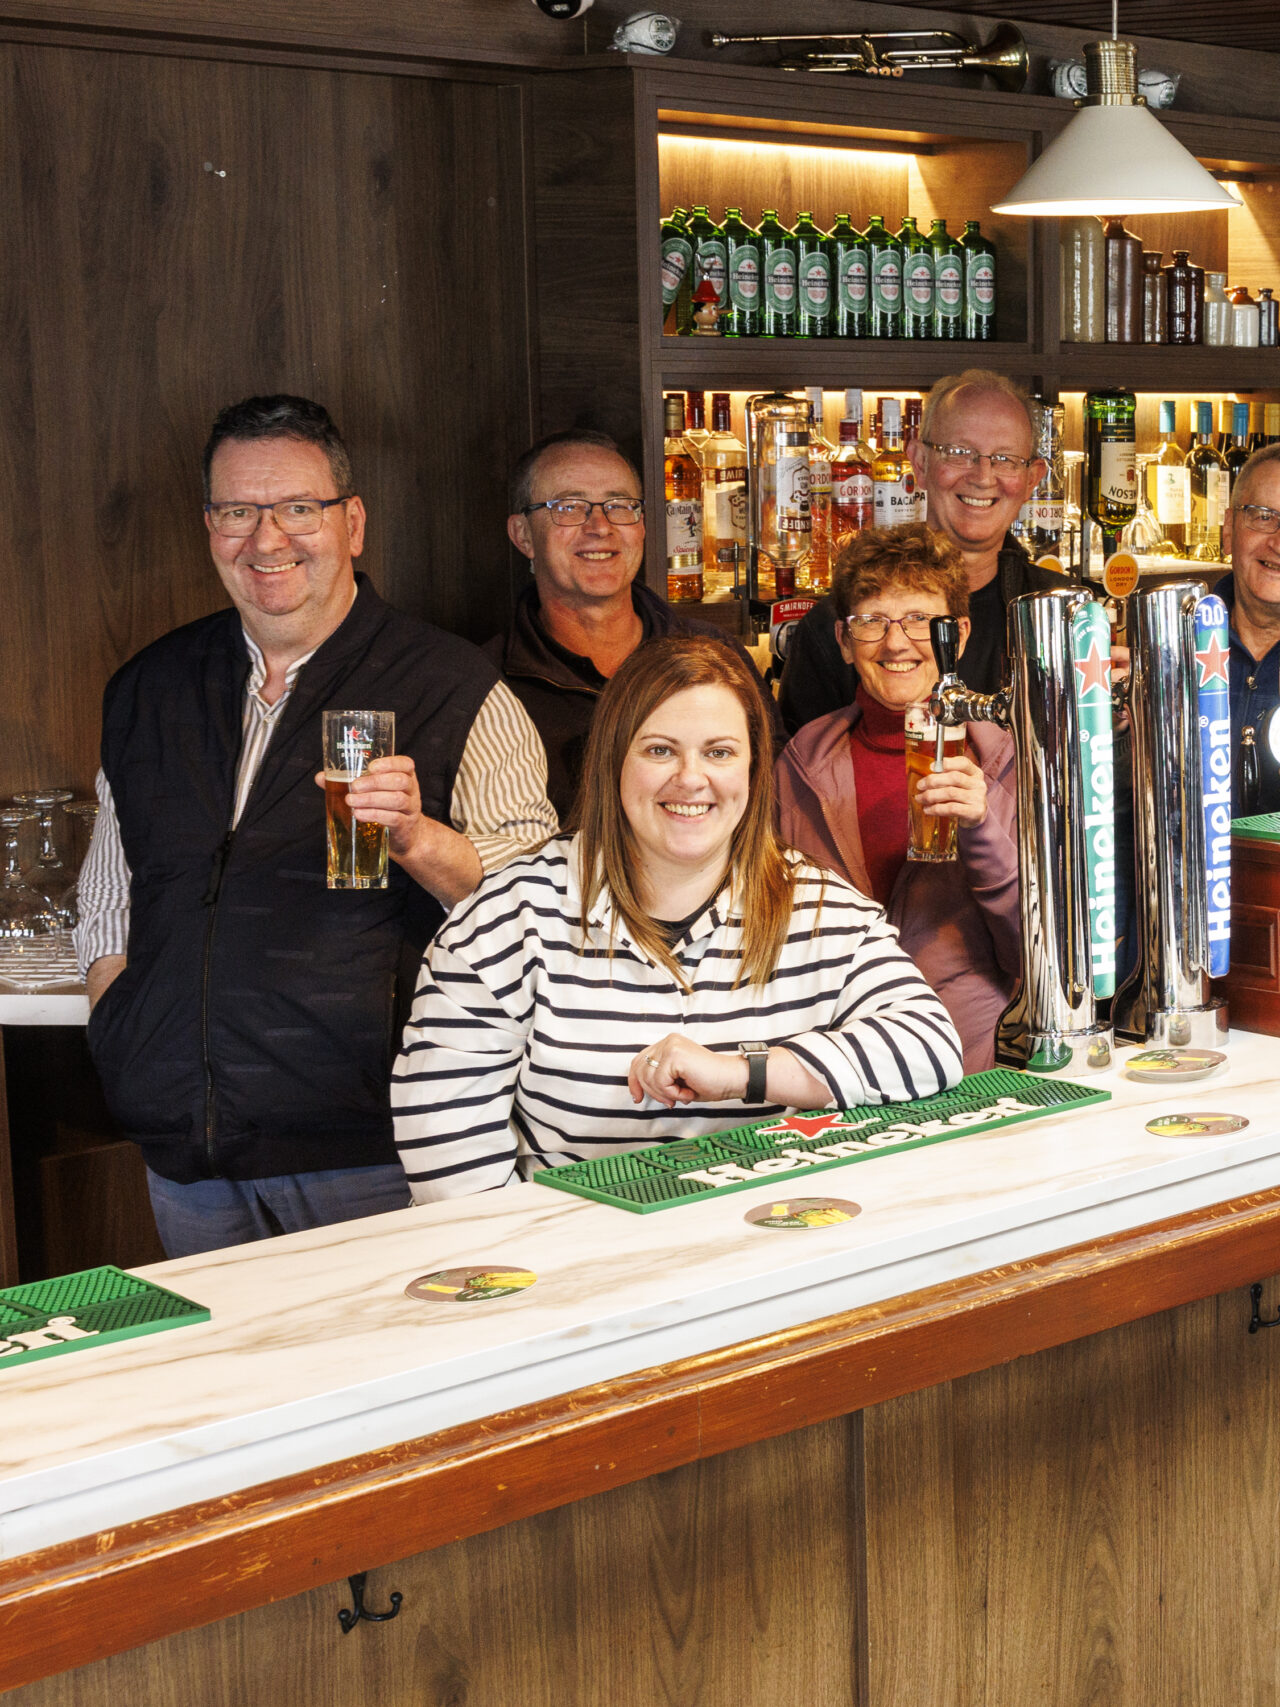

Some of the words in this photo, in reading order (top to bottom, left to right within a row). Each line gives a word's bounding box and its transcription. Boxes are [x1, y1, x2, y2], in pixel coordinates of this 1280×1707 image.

[840, 485, 872, 496] GORDON
[1108, 485, 1136, 500] ESON
[779, 602, 814, 613] SMIRNOFF
[1199, 603, 1225, 627] 0.0
[1203, 716, 1232, 944] Heineken
[1084, 729, 1117, 977] Heineken
[677, 1097, 1047, 1188] Heineken
